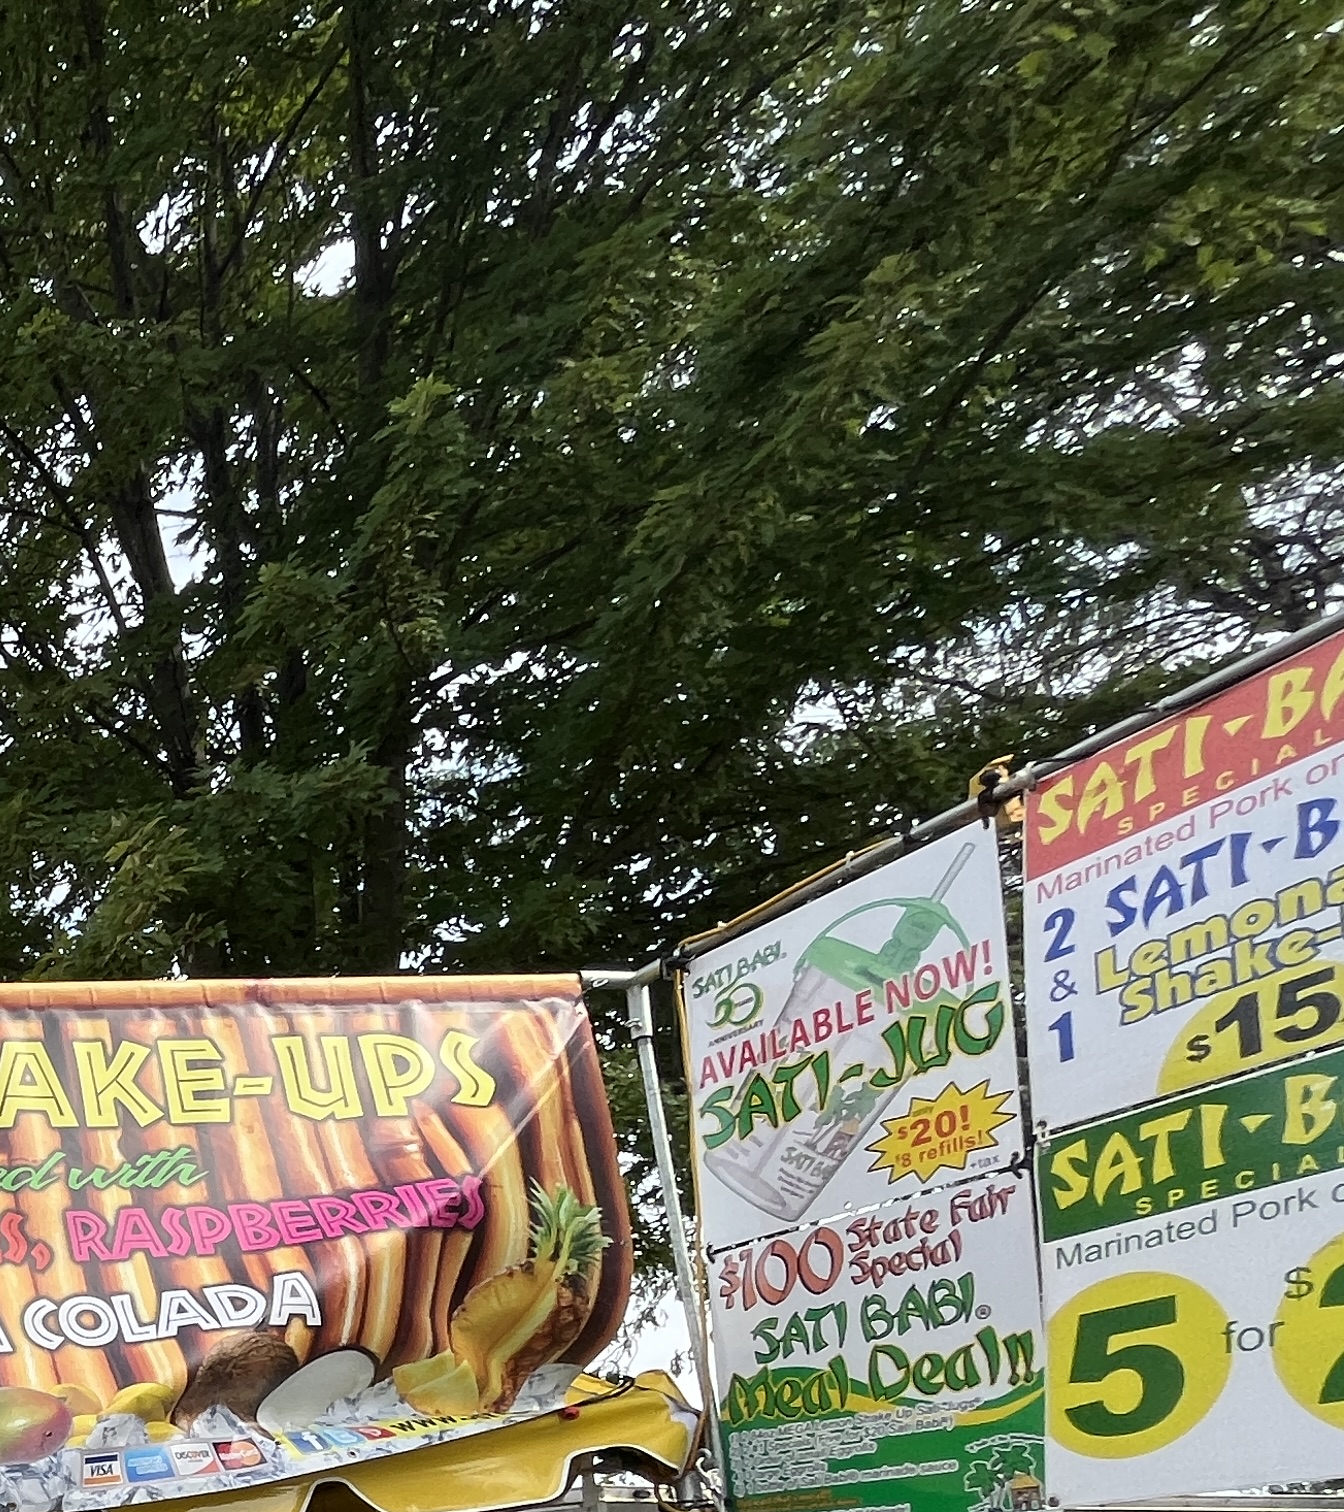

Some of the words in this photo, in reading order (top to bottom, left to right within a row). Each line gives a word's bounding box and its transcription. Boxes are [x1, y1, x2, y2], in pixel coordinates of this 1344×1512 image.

[1037, 816, 1196, 904] Marinated
[1210, 777, 1293, 829] Pork
[1043, 908, 1076, 962] 2
[692, 963, 733, 999] SATI
[699, 990, 875, 1089] AVAILABLE
[885, 940, 993, 1013] NOW!
[1050, 969, 1078, 1002] &
[1186, 967, 1343, 1063] $15
[700, 981, 1004, 1150] SATI-JUG
[1048, 1011, 1075, 1063] 1
[897, 1105, 970, 1147] $20!
[919, 1129, 983, 1162] refills!
[69, 1146, 208, 1191] with
[68, 1176, 486, 1264] RASPBERRIES
[720, 1227, 844, 1312] $100
[847, 1205, 940, 1251] State
[951, 1185, 1016, 1226] Fair
[1055, 1210, 1218, 1270] Marinated
[1232, 1187, 1318, 1229] Pork
[849, 1230, 963, 1288] Special
[23, 1270, 322, 1350] COLADA
[752, 1302, 847, 1364] SATI
[729, 1355, 849, 1426] Meal
[868, 1326, 1034, 1402] Deal!!
[1065, 1295, 1185, 1437] 5
[1222, 1320, 1286, 1354] for
[90, 1463, 114, 1478] VISA
